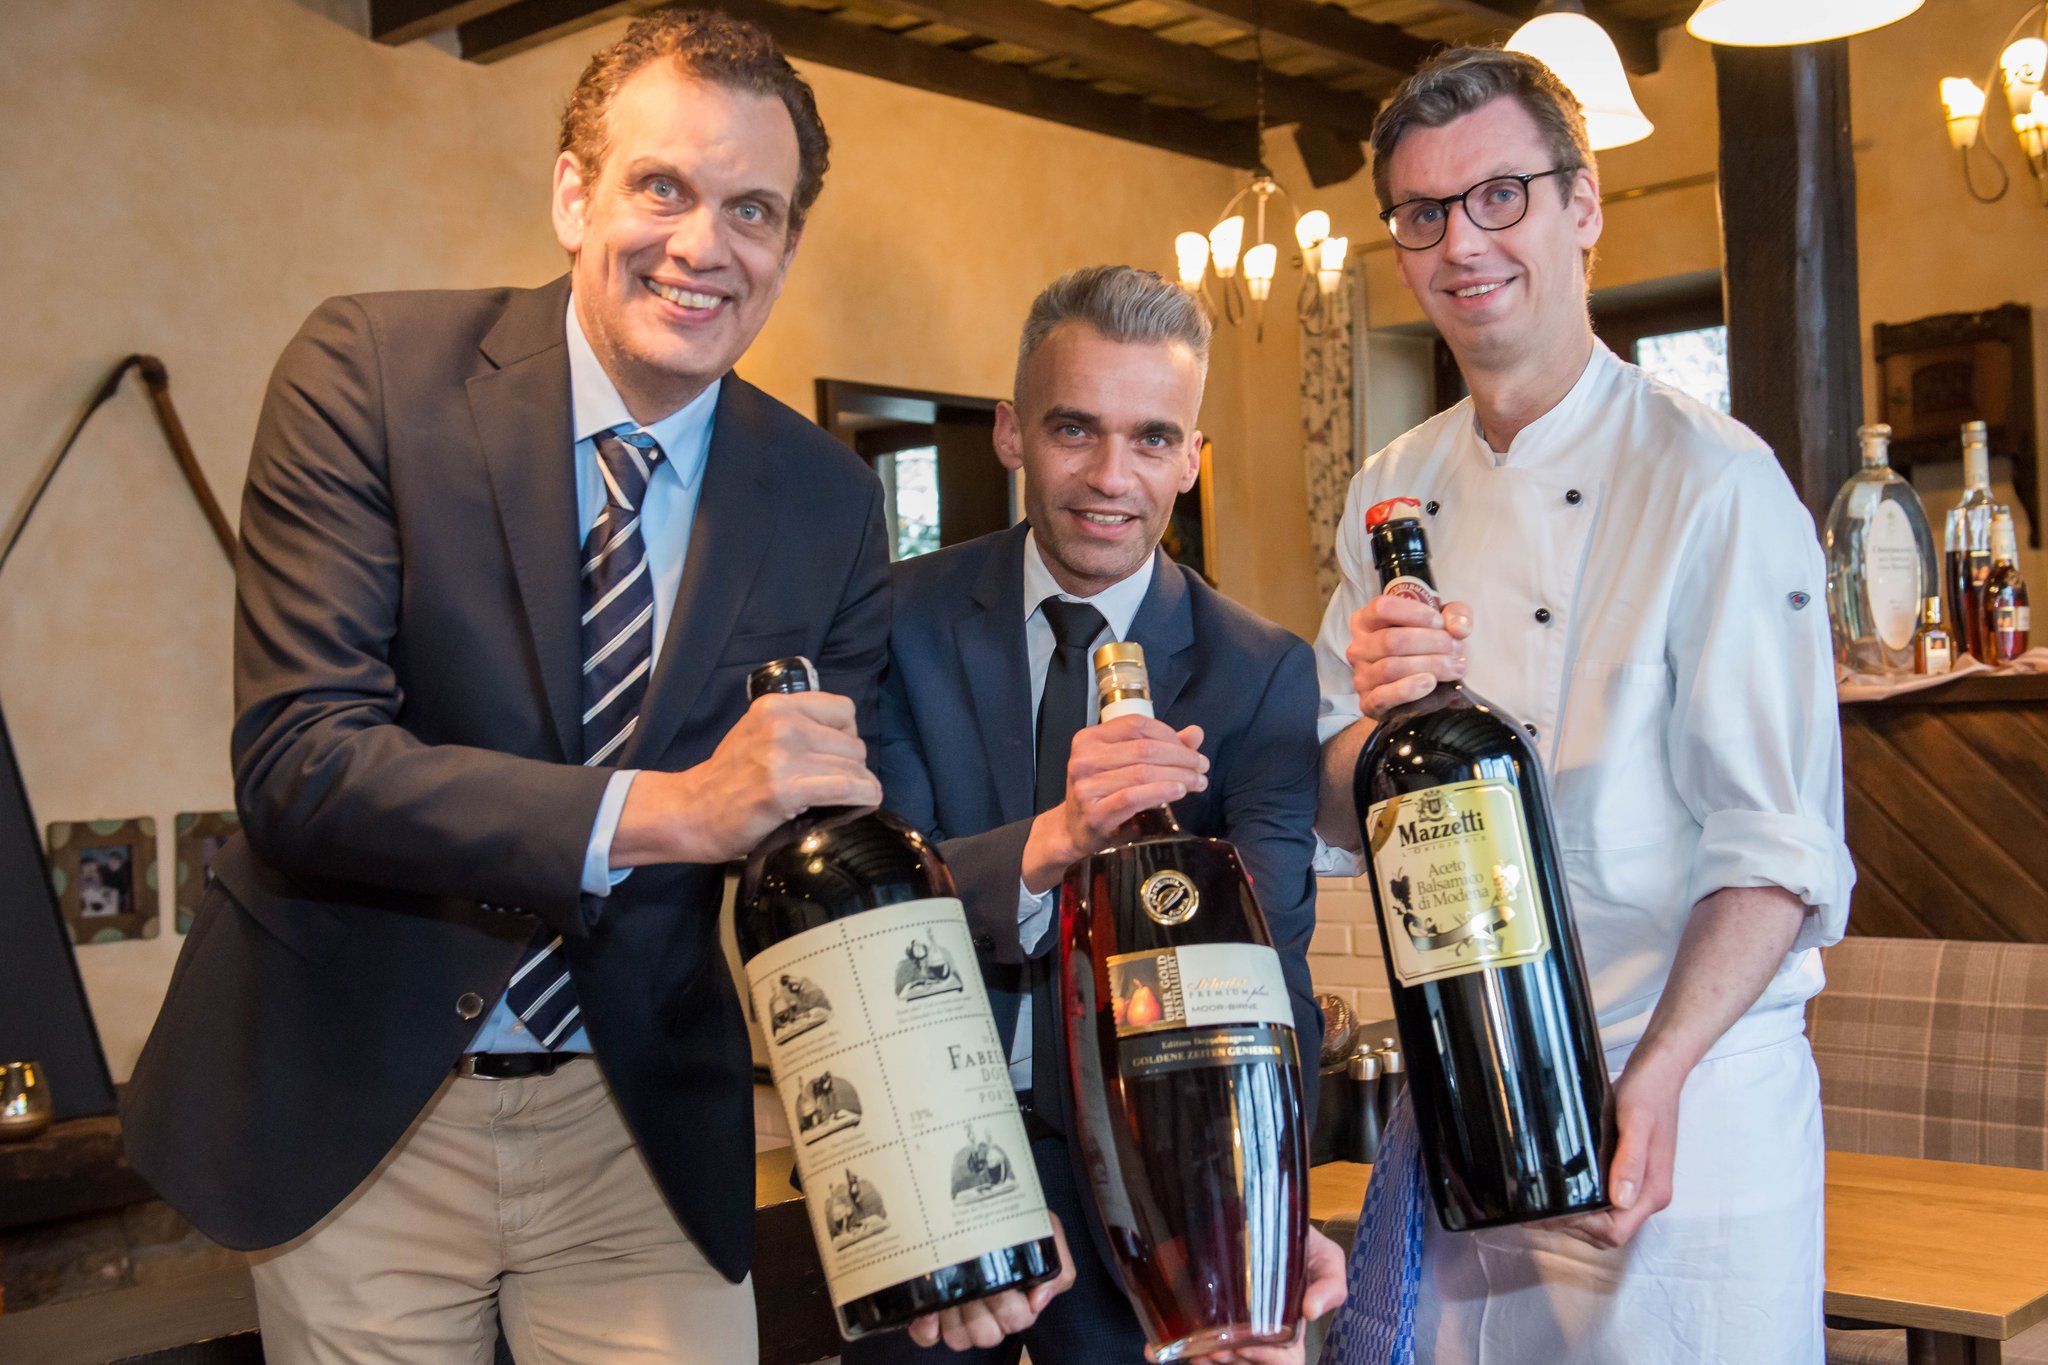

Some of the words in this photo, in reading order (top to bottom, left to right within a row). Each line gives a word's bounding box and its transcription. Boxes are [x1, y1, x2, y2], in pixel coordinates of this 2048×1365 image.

[1397, 809, 1485, 847] Mazzetti
[1428, 860, 1467, 878] Aceto
[1416, 873, 1484, 896] Balsamico
[1418, 895, 1431, 911] di
[1432, 887, 1489, 908] Modena
[1157, 954, 1171, 989] GOLD
[1167, 954, 1185, 1021] DESTILLIERT
[1188, 988, 1249, 999] PREMIUM
[1132, 1051, 1185, 1067] GOLDENE
[1187, 1047, 1227, 1060] ZEITEN
